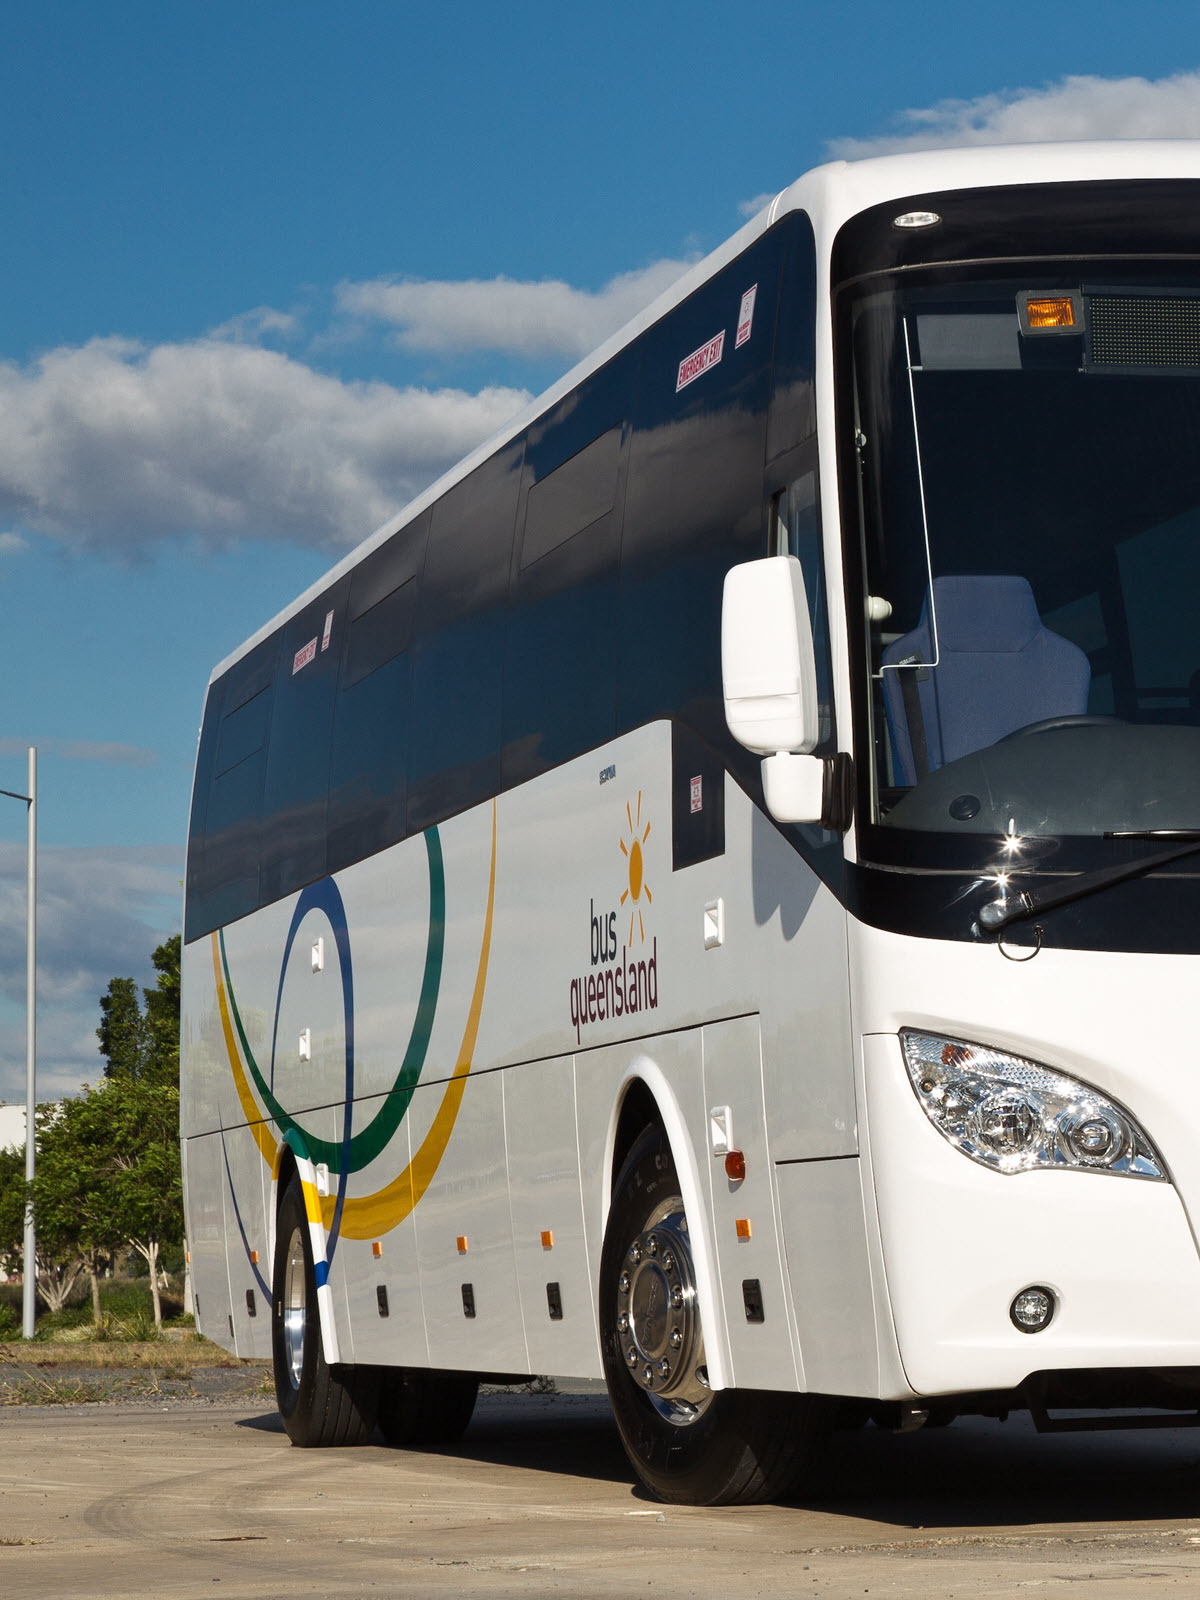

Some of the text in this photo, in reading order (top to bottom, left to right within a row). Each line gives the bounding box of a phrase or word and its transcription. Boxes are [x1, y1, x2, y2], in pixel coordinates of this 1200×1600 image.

[678, 337, 723, 386] EMERGENCY EXIT
[590, 898, 618, 966] bus
[570, 936, 658, 1045] queensland
